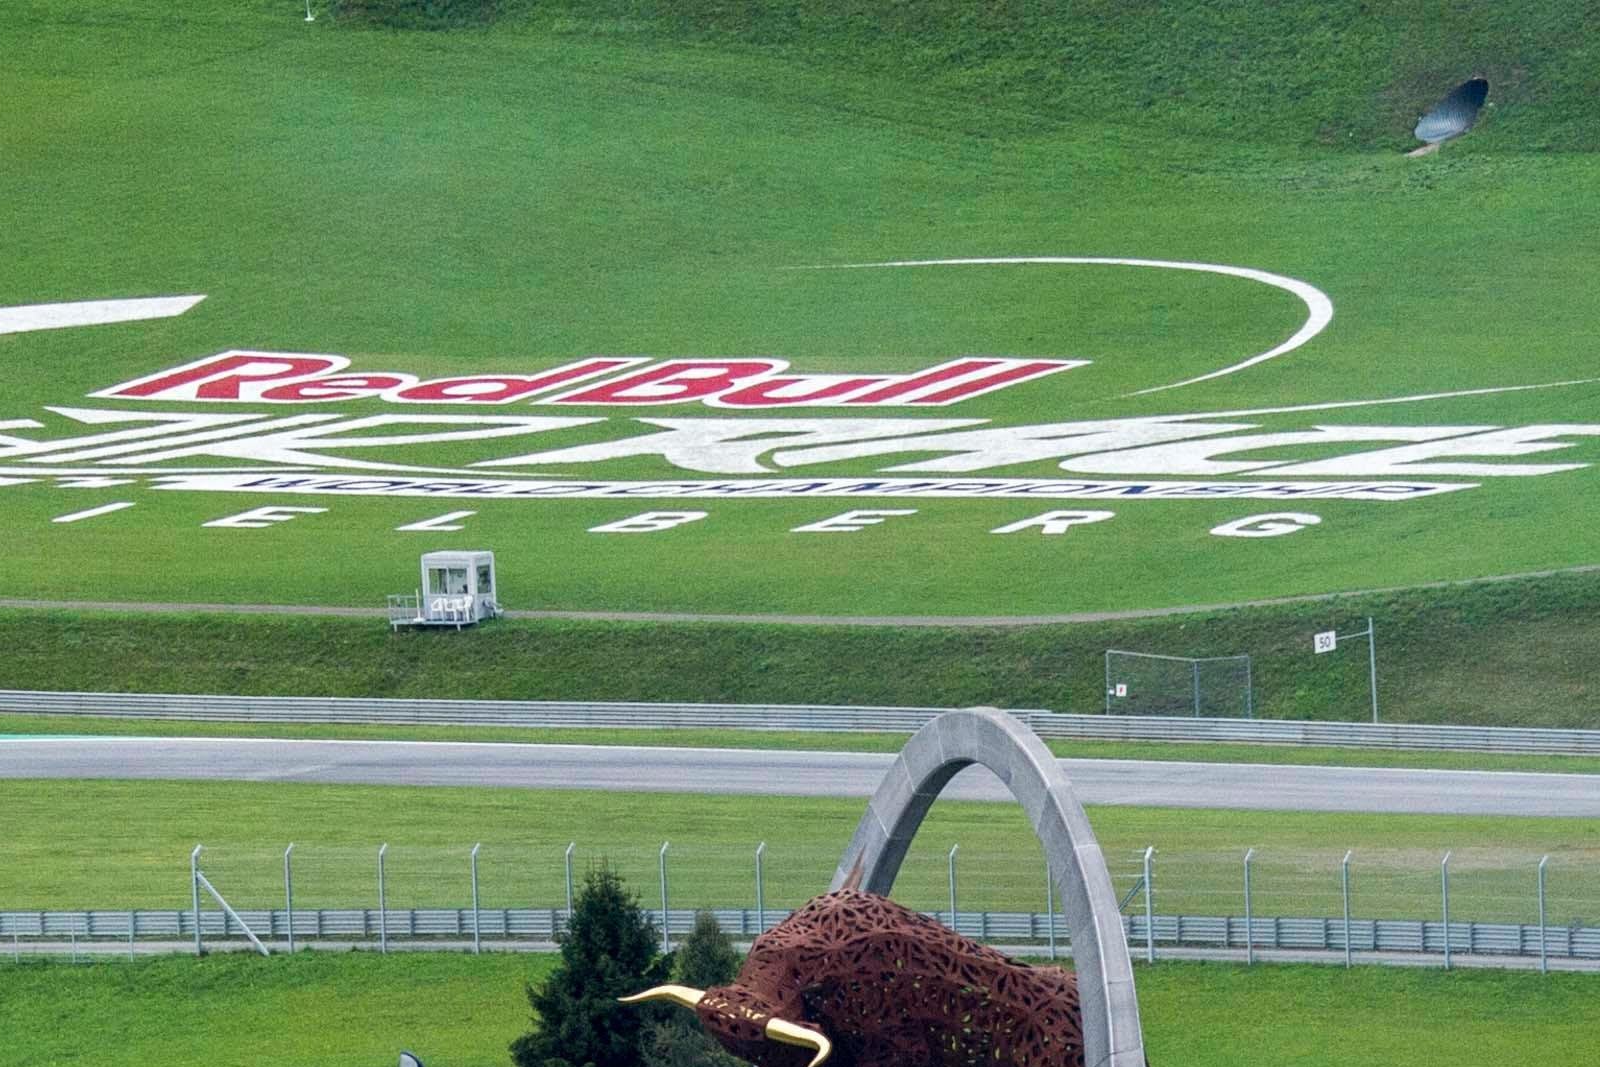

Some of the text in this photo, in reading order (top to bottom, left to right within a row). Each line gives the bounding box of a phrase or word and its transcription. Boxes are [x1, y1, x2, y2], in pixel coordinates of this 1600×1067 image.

[98, 351, 1084, 407] Red Bull
[466, 418, 1600, 476] RACE
[237, 478, 1436, 496] WORLD CHAMPIONSHIP
